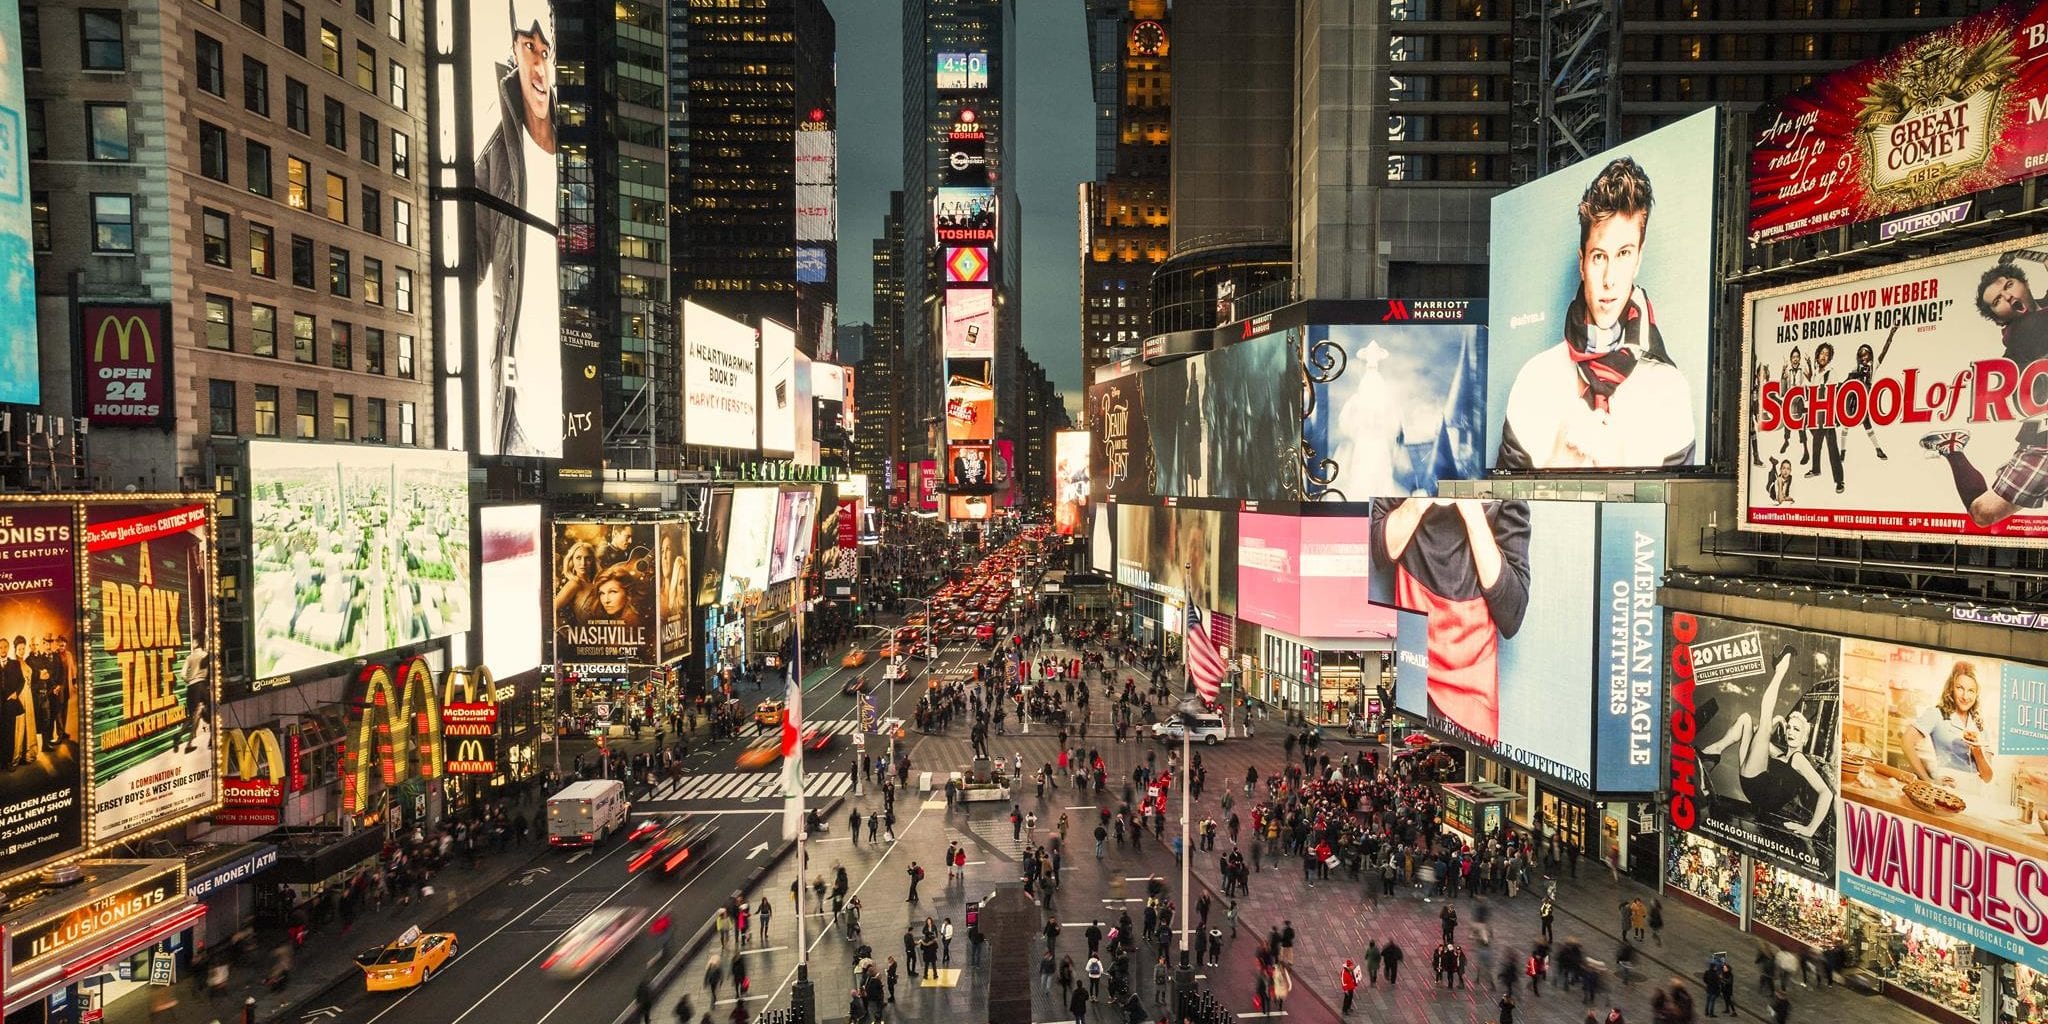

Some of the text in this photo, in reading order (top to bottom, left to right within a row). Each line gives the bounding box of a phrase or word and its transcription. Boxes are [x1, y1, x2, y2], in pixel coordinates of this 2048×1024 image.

[944, 58, 980, 72] 4:50
[954, 124, 979, 132] 2017
[1756, 109, 1819, 148] Are you
[1890, 102, 1968, 148] GREAT
[1768, 126, 1826, 179] ready to
[1888, 126, 1969, 170] COMET
[1778, 152, 1852, 204] wake up?
[1912, 167, 1940, 184] 1812
[1762, 224, 1784, 238] IMPERIAL
[1785, 218, 1808, 232] THEATRE
[1888, 207, 1961, 236] OUTFRONT
[938, 229, 994, 240] TOSHIBA
[1414, 301, 1468, 309] MARRIOTT
[1777, 278, 1938, 322] “ANDREW LLOYD WEBBER
[1252, 314, 1272, 326] MARRIOTT
[1414, 310, 1462, 318] MARQUIS
[1776, 300, 1953, 344] HAS BROADWAY ROCKING!”
[690, 342, 754, 374] A HEARTWARMING
[99, 367, 152, 380] OPEN
[710, 367, 737, 387] BOOK BY
[106, 382, 146, 400] 24
[690, 392, 720, 408] HARVEY
[1758, 368, 1932, 432] SCHOOL
[1926, 370, 1972, 422] of
[94, 404, 160, 416] HOURS
[1102, 394, 1129, 443] BEAUTY
[740, 462, 776, 480] 1540
[1106, 440, 1130, 489] BEAST
[101, 530, 117, 540] New
[118, 526, 136, 540] York
[136, 523, 157, 534] Times
[188, 508, 205, 522] PICK
[1834, 514, 1854, 524] WINTER
[1855, 516, 1877, 525] GARDEN
[1878, 516, 1903, 526] THEATRE
[1924, 518, 1929, 527] &
[1930, 518, 1966, 530] BROADWAY
[0, 526, 70, 544] ONISTS
[14, 548, 65, 558] CENTURY
[139, 540, 152, 584] A
[0, 578, 53, 592] RVOYANTS
[1632, 530, 1657, 674] AMERICAN
[102, 580, 182, 651] BRONX
[567, 626, 646, 646] NASHVILLE
[619, 646, 638, 656] CMT
[1610, 580, 1630, 716] OUTFITTERS
[1692, 636, 1759, 666] 20 YEARS
[573, 664, 629, 674] LUGGAGE
[1699, 668, 1720, 680] KILLING
[1726, 662, 1758, 675] WORLDWIDE
[117, 649, 177, 719] TALE
[480, 684, 515, 702] ERESS
[2012, 679, 2018, 700] A
[444, 708, 495, 717] McDonald's
[1630, 680, 1652, 766] EAGLE
[1671, 611, 1698, 831] CHICAGO
[2018, 704, 2032, 726] OF
[1426, 716, 1590, 788] AMERICAN EAGLE OUTFITTERS
[136, 768, 174, 789] COMBINATION
[175, 766, 181, 777] OF
[152, 777, 187, 795] WEST SIDE
[3, 792, 57, 814] GOLDEN AGE
[59, 788, 71, 798] OF
[96, 796, 123, 814] JERSEY
[125, 790, 145, 804] BOYS
[145, 788, 150, 797] &
[7, 813, 24, 825] ALL
[25, 806, 46, 819] NEW
[47, 798, 72, 812] SHOW
[2, 816, 52, 840] 25-JANUARY
[17, 832, 60, 850] Palace Theatre
[1706, 818, 1820, 866] CHICAGOTHEMUSICAL.COM
[188, 851, 276, 896] NGE MONEY ATM
[93, 894, 117, 910] THE
[31, 887, 165, 957] ILLUSIONISTS
